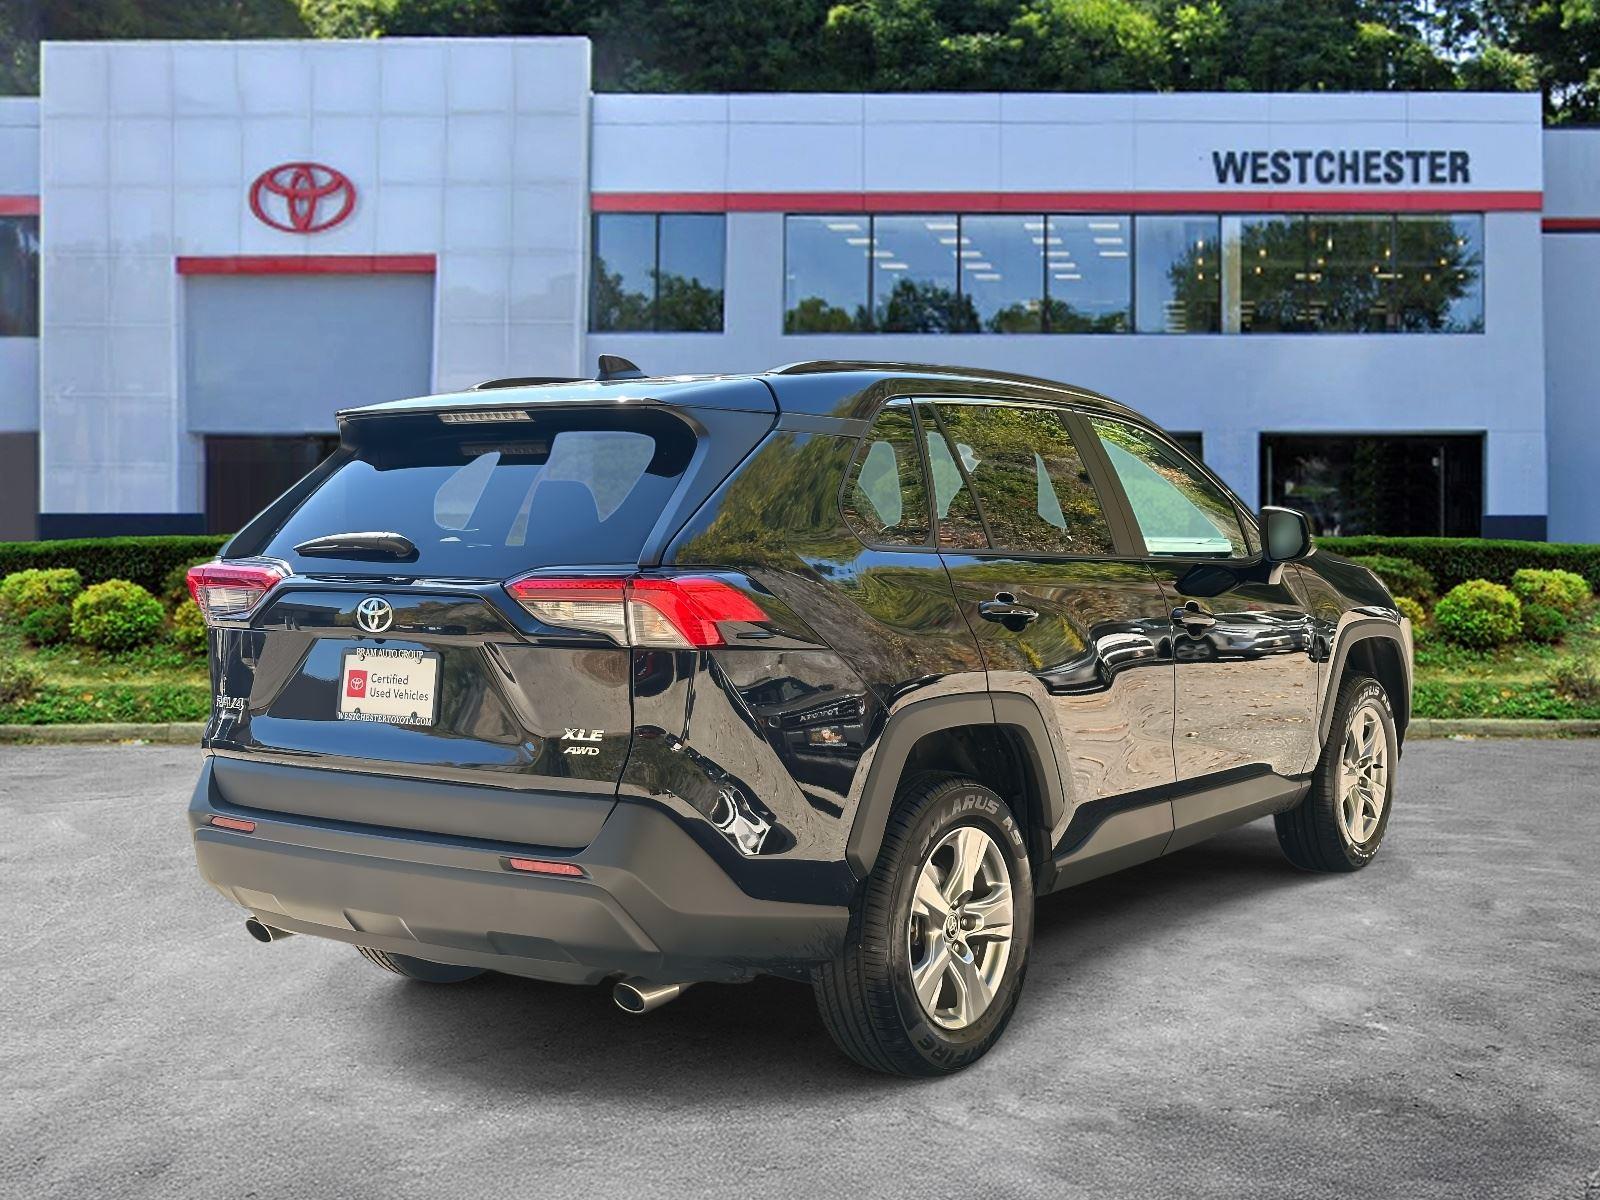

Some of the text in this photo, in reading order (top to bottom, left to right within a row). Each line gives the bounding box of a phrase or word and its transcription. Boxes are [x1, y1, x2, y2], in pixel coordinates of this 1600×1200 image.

[1212, 150, 1471, 184] WESTCHESTER
[379, 649, 398, 658] AUTO
[399, 650, 424, 659] GROUP
[371, 673, 409, 685] Certified
[369, 687, 429, 701] Used Vehicles
[337, 711, 432, 726] WESTCHESTERTOYOTA.COM
[561, 728, 605, 741] XLE
[563, 746, 600, 756] AWD
[1002, 815, 1023, 846] AS
